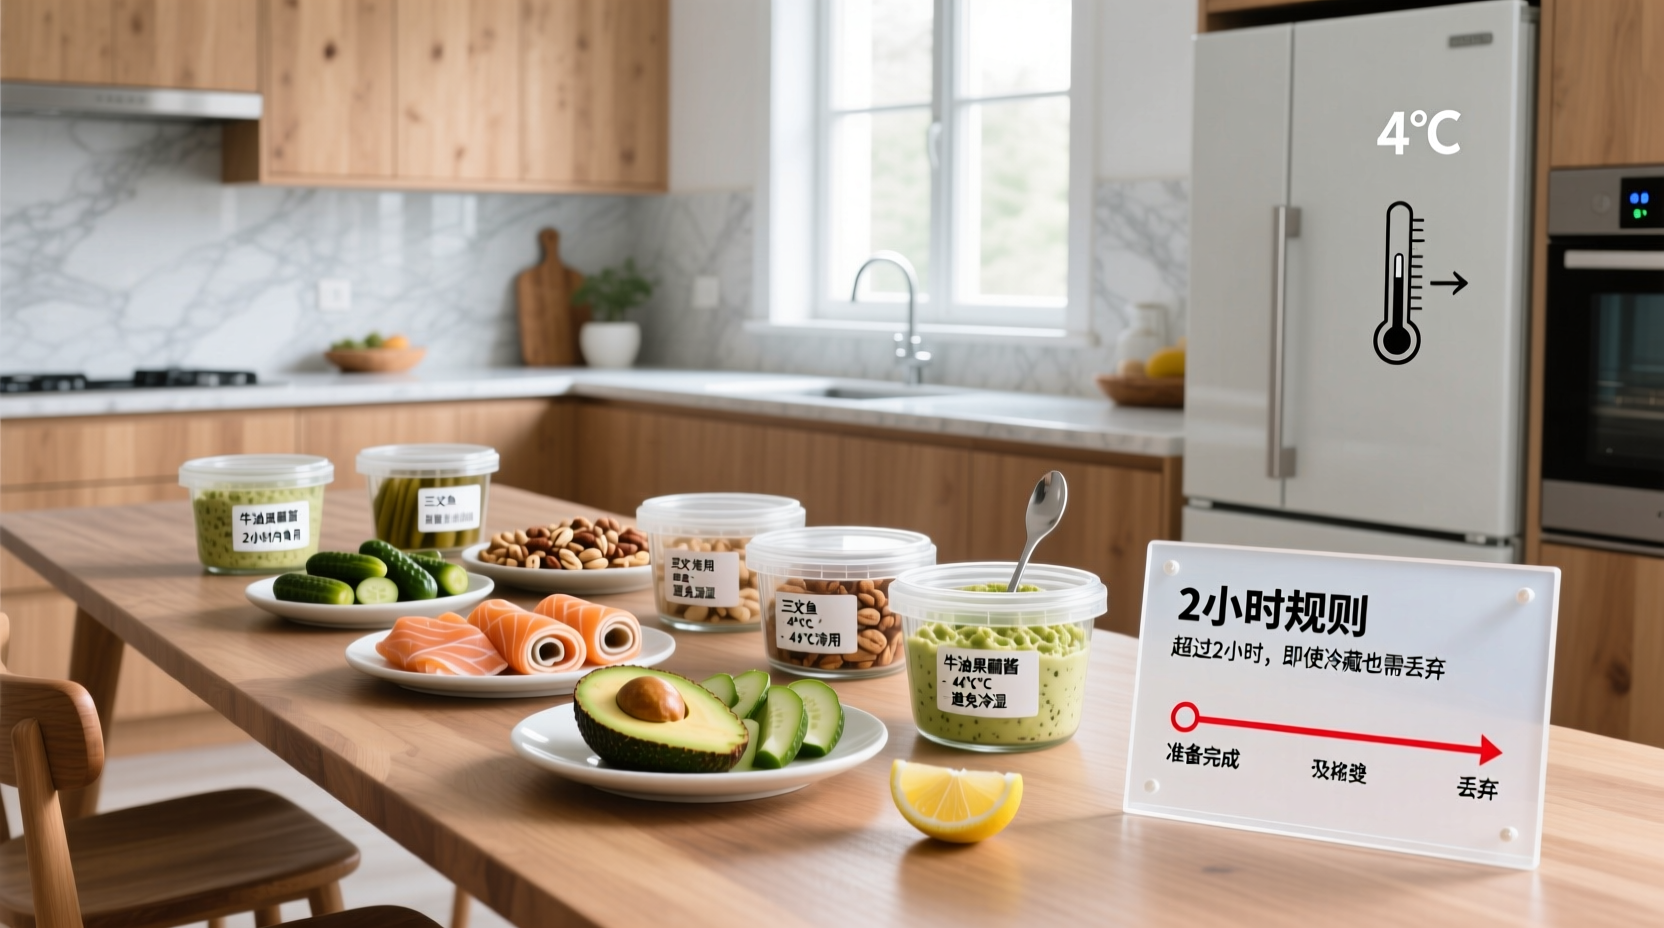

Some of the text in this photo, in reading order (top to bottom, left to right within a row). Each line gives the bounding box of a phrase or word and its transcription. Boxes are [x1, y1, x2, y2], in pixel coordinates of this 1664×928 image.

[1178, 585, 1369, 638] 2小时规则
[1166, 742, 1241, 770] 准备完成
[1457, 776, 1500, 801] 丢弃
